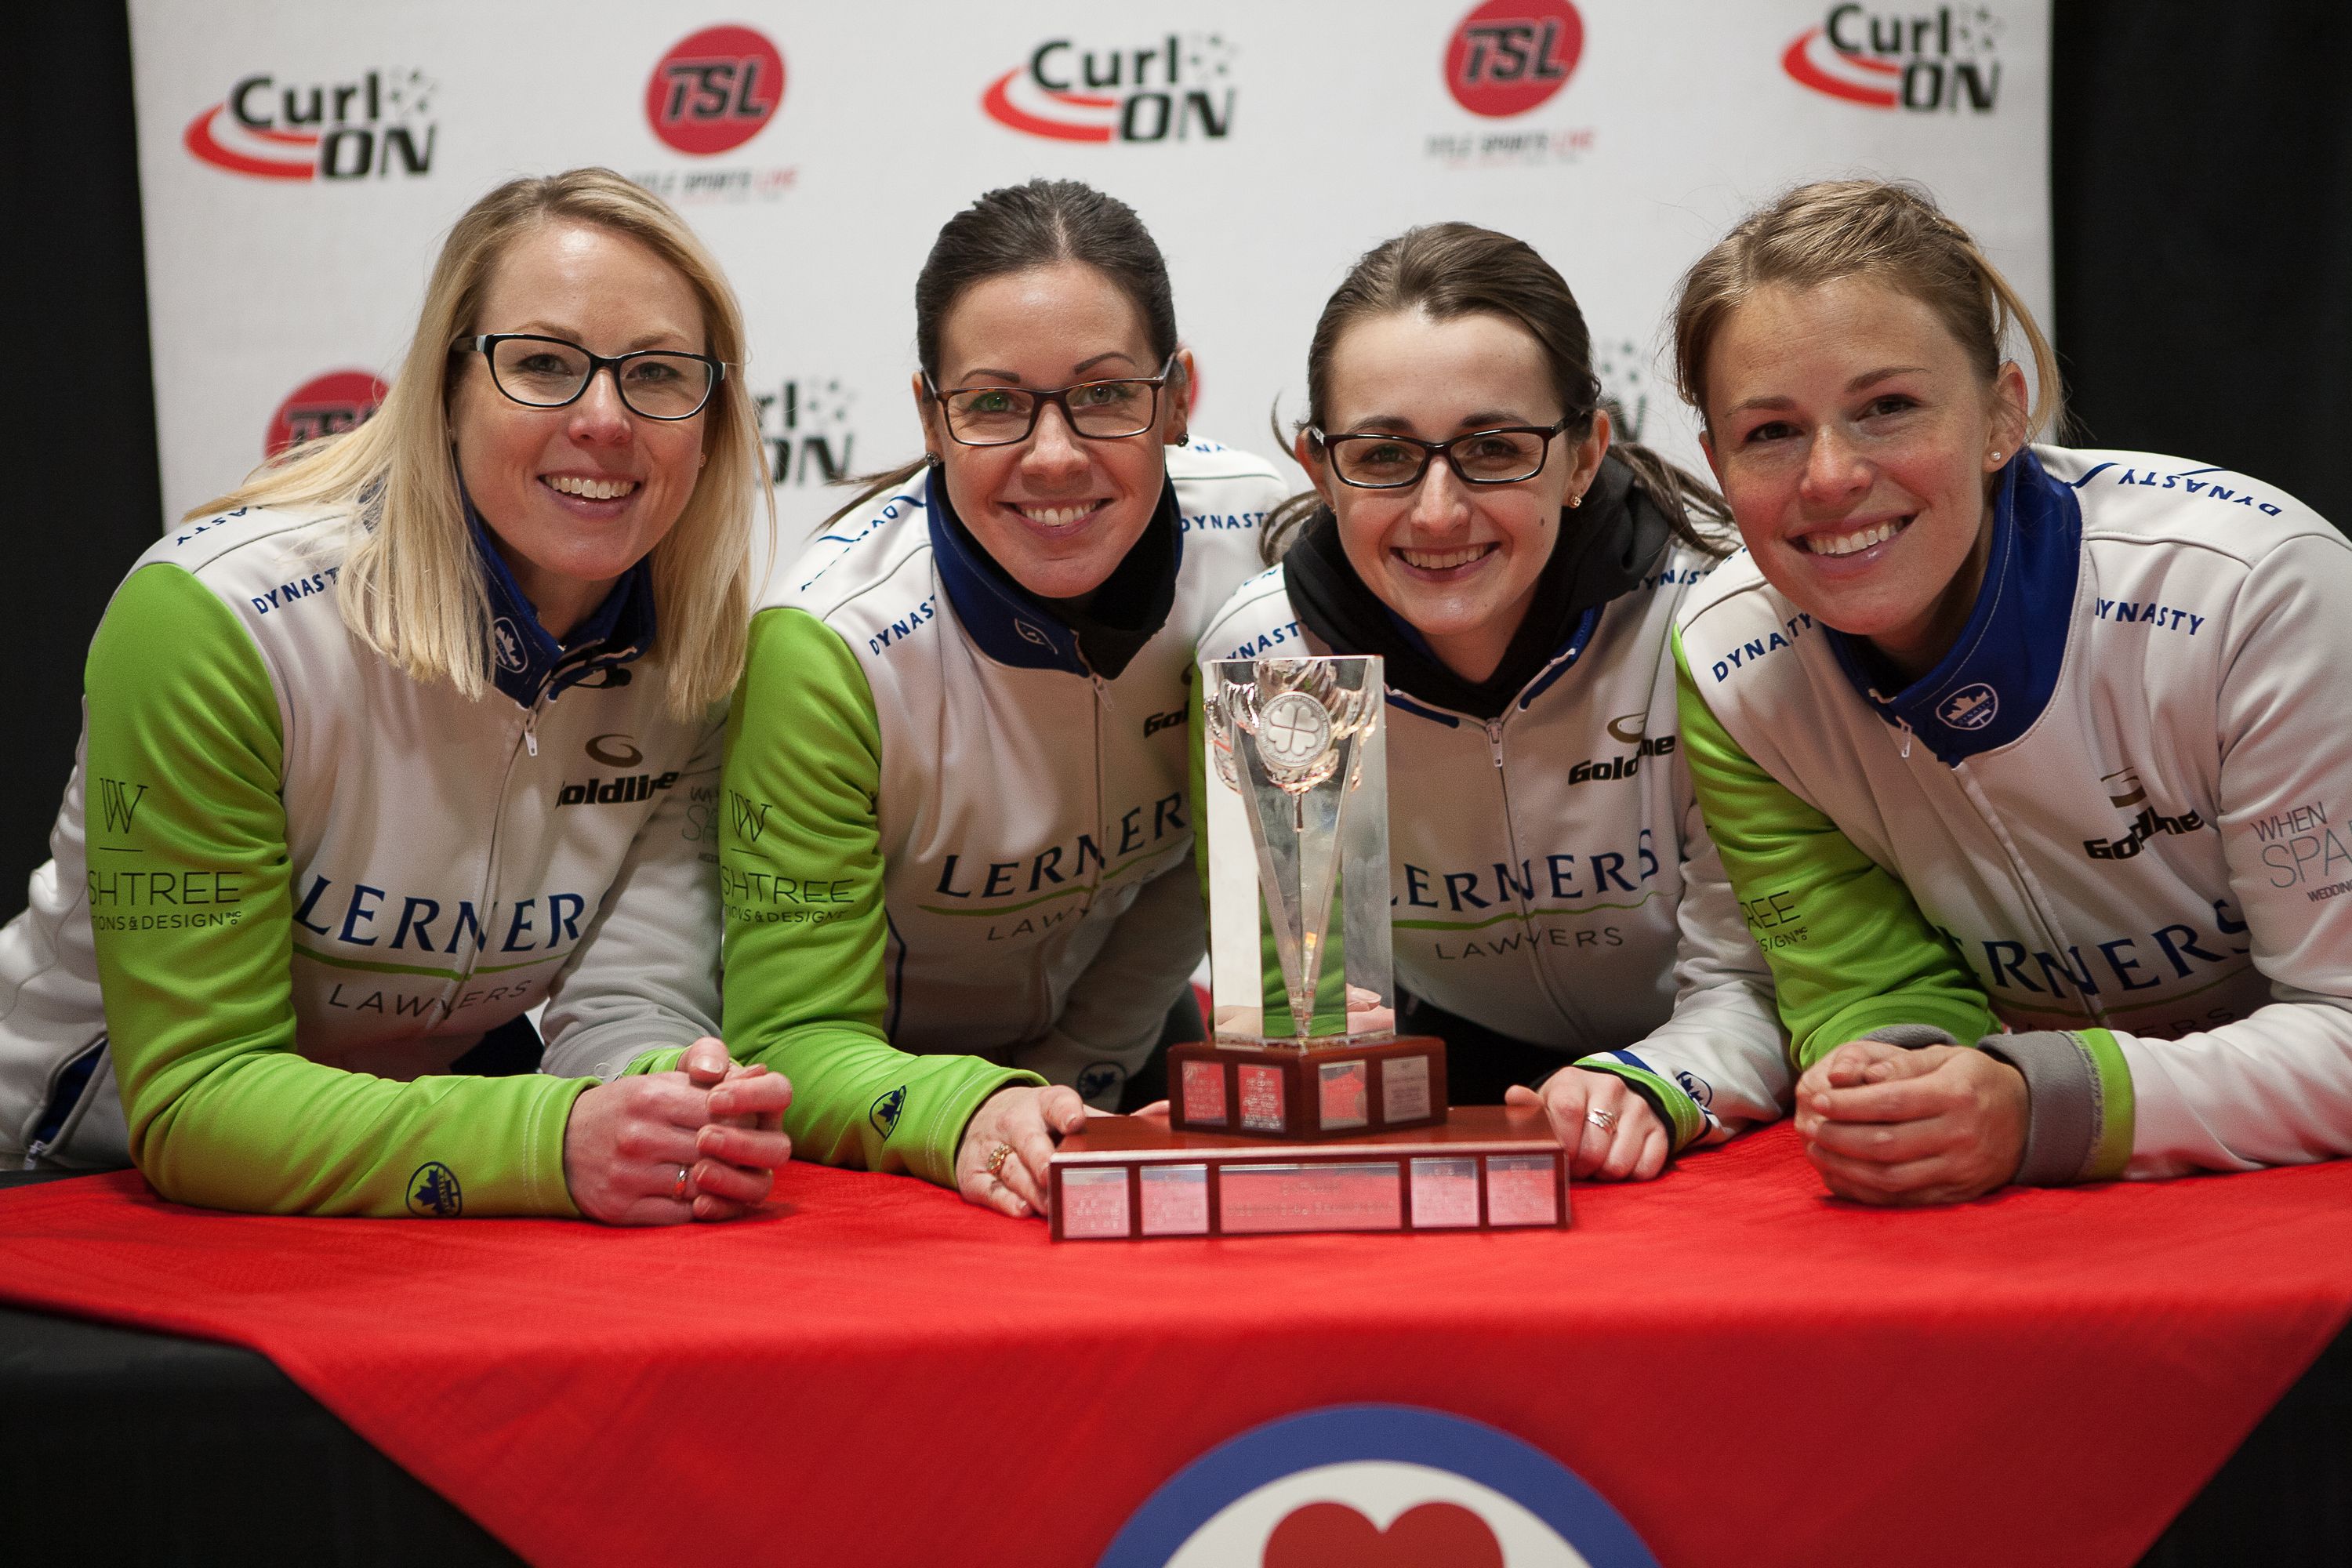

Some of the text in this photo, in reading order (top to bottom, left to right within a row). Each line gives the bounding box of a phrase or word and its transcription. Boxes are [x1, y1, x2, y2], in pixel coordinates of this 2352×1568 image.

[1465, 21, 1566, 82] TSL
[1826, 2, 1951, 56] Curl
[667, 60, 768, 121] TSL
[1031, 34, 1179, 92] Curl
[1904, 60, 2002, 114] ON
[230, 67, 381, 130] Curl
[1121, 88, 1236, 143] ON
[321, 124, 437, 180] ON
[2118, 468, 2283, 516] DYNASTY
[251, 567, 339, 615] DYNAST
[2250, 801, 2328, 842] WHEN
[1391, 829, 1660, 912] ERNERS
[2262, 820, 2352, 888] SPA
[141, 913, 223, 931] DESIGN
[293, 874, 610, 955] LERNER
[1436, 926, 1624, 960] LAWYERS
